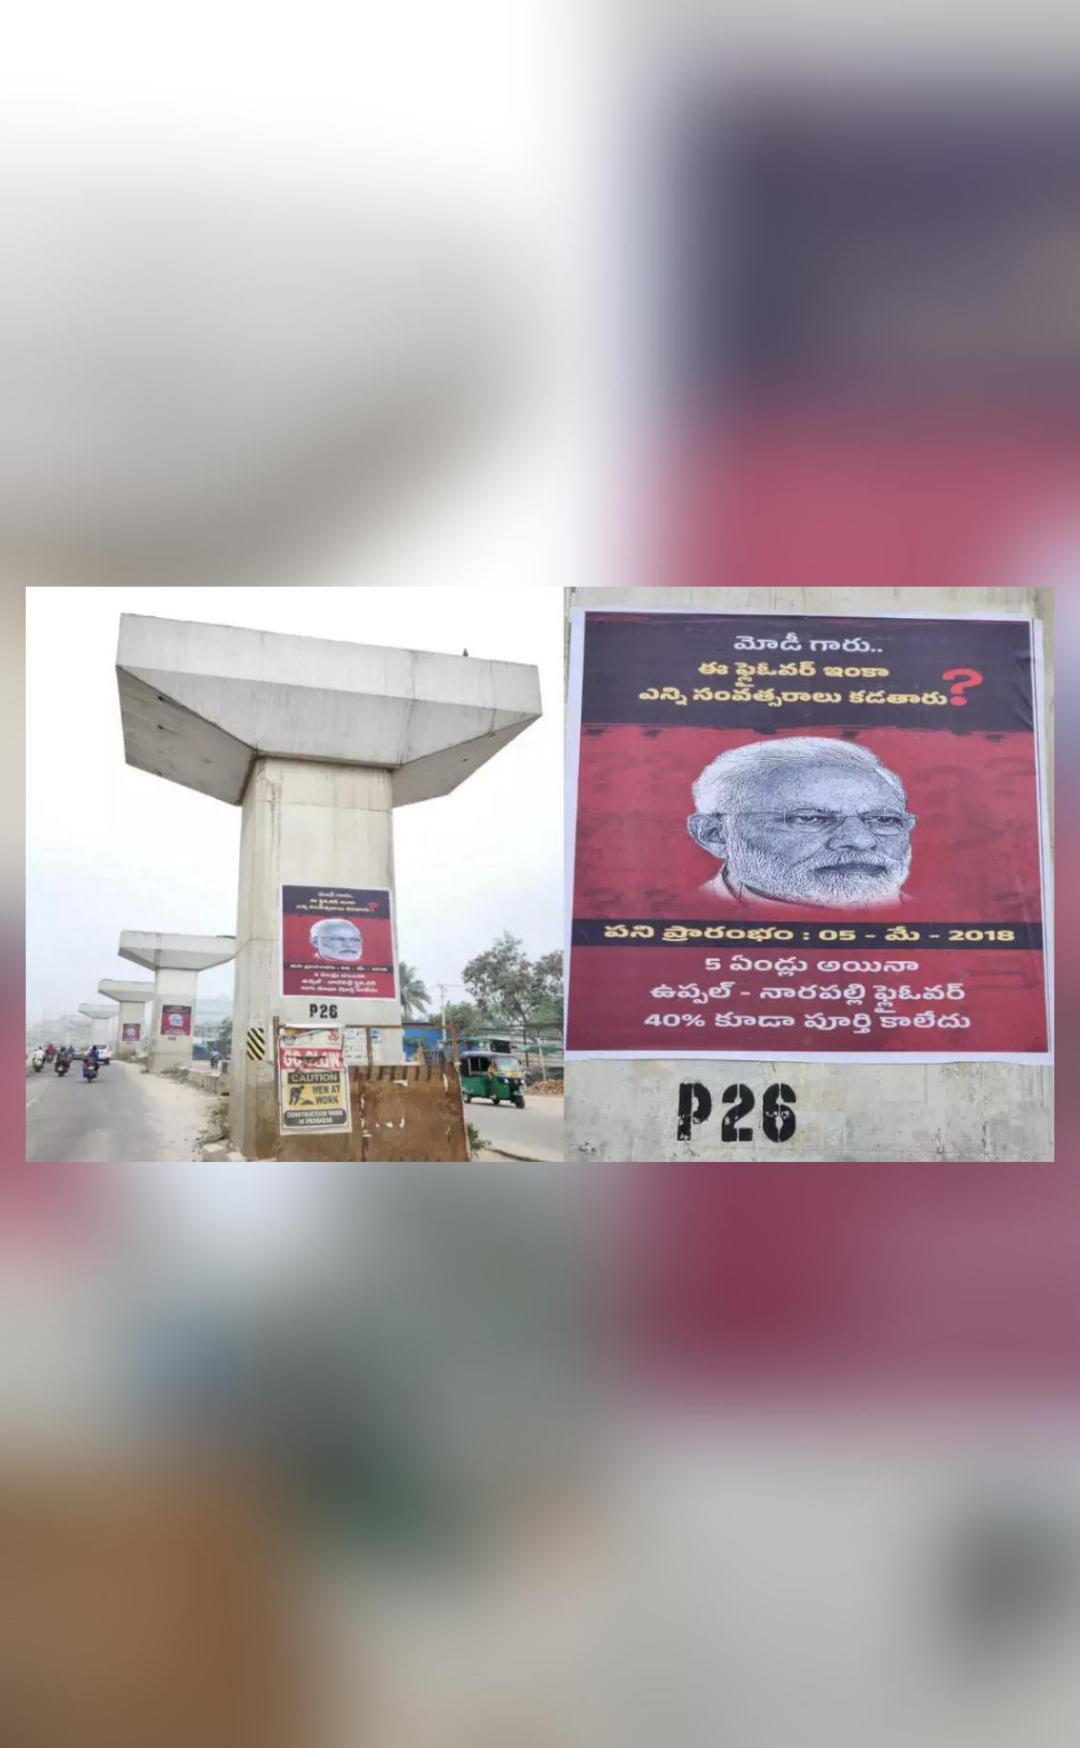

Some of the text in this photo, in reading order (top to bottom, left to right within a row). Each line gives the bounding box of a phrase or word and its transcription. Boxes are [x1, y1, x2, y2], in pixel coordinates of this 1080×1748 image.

[733, 632, 802, 651] మోడీ
[698, 661, 729, 675] ఈ
[823, 665, 890, 678] ఇంకా
[638, 686, 688, 706] ఎన్ని
[692, 687, 842, 708] సంవత్సరాలు
[604, 924, 654, 938] పని
[662, 925, 794, 942] ప్రారంభం
[818, 929, 856, 941] 05
[884, 925, 920, 941] మే
[948, 929, 1016, 941] 2018
[704, 957, 721, 971] 5
[817, 960, 920, 972] అయినా
[650, 981, 736, 1004] ఉప్పల్
[759, 983, 866, 1006] నారపల్లి
[309, 1003, 339, 1019] P26
[644, 1010, 971, 1034] 40% కూడా పూర్తి కాలేదు
[291, 1073, 338, 1083] CAUTION
[676, 1082, 797, 1143] P26
